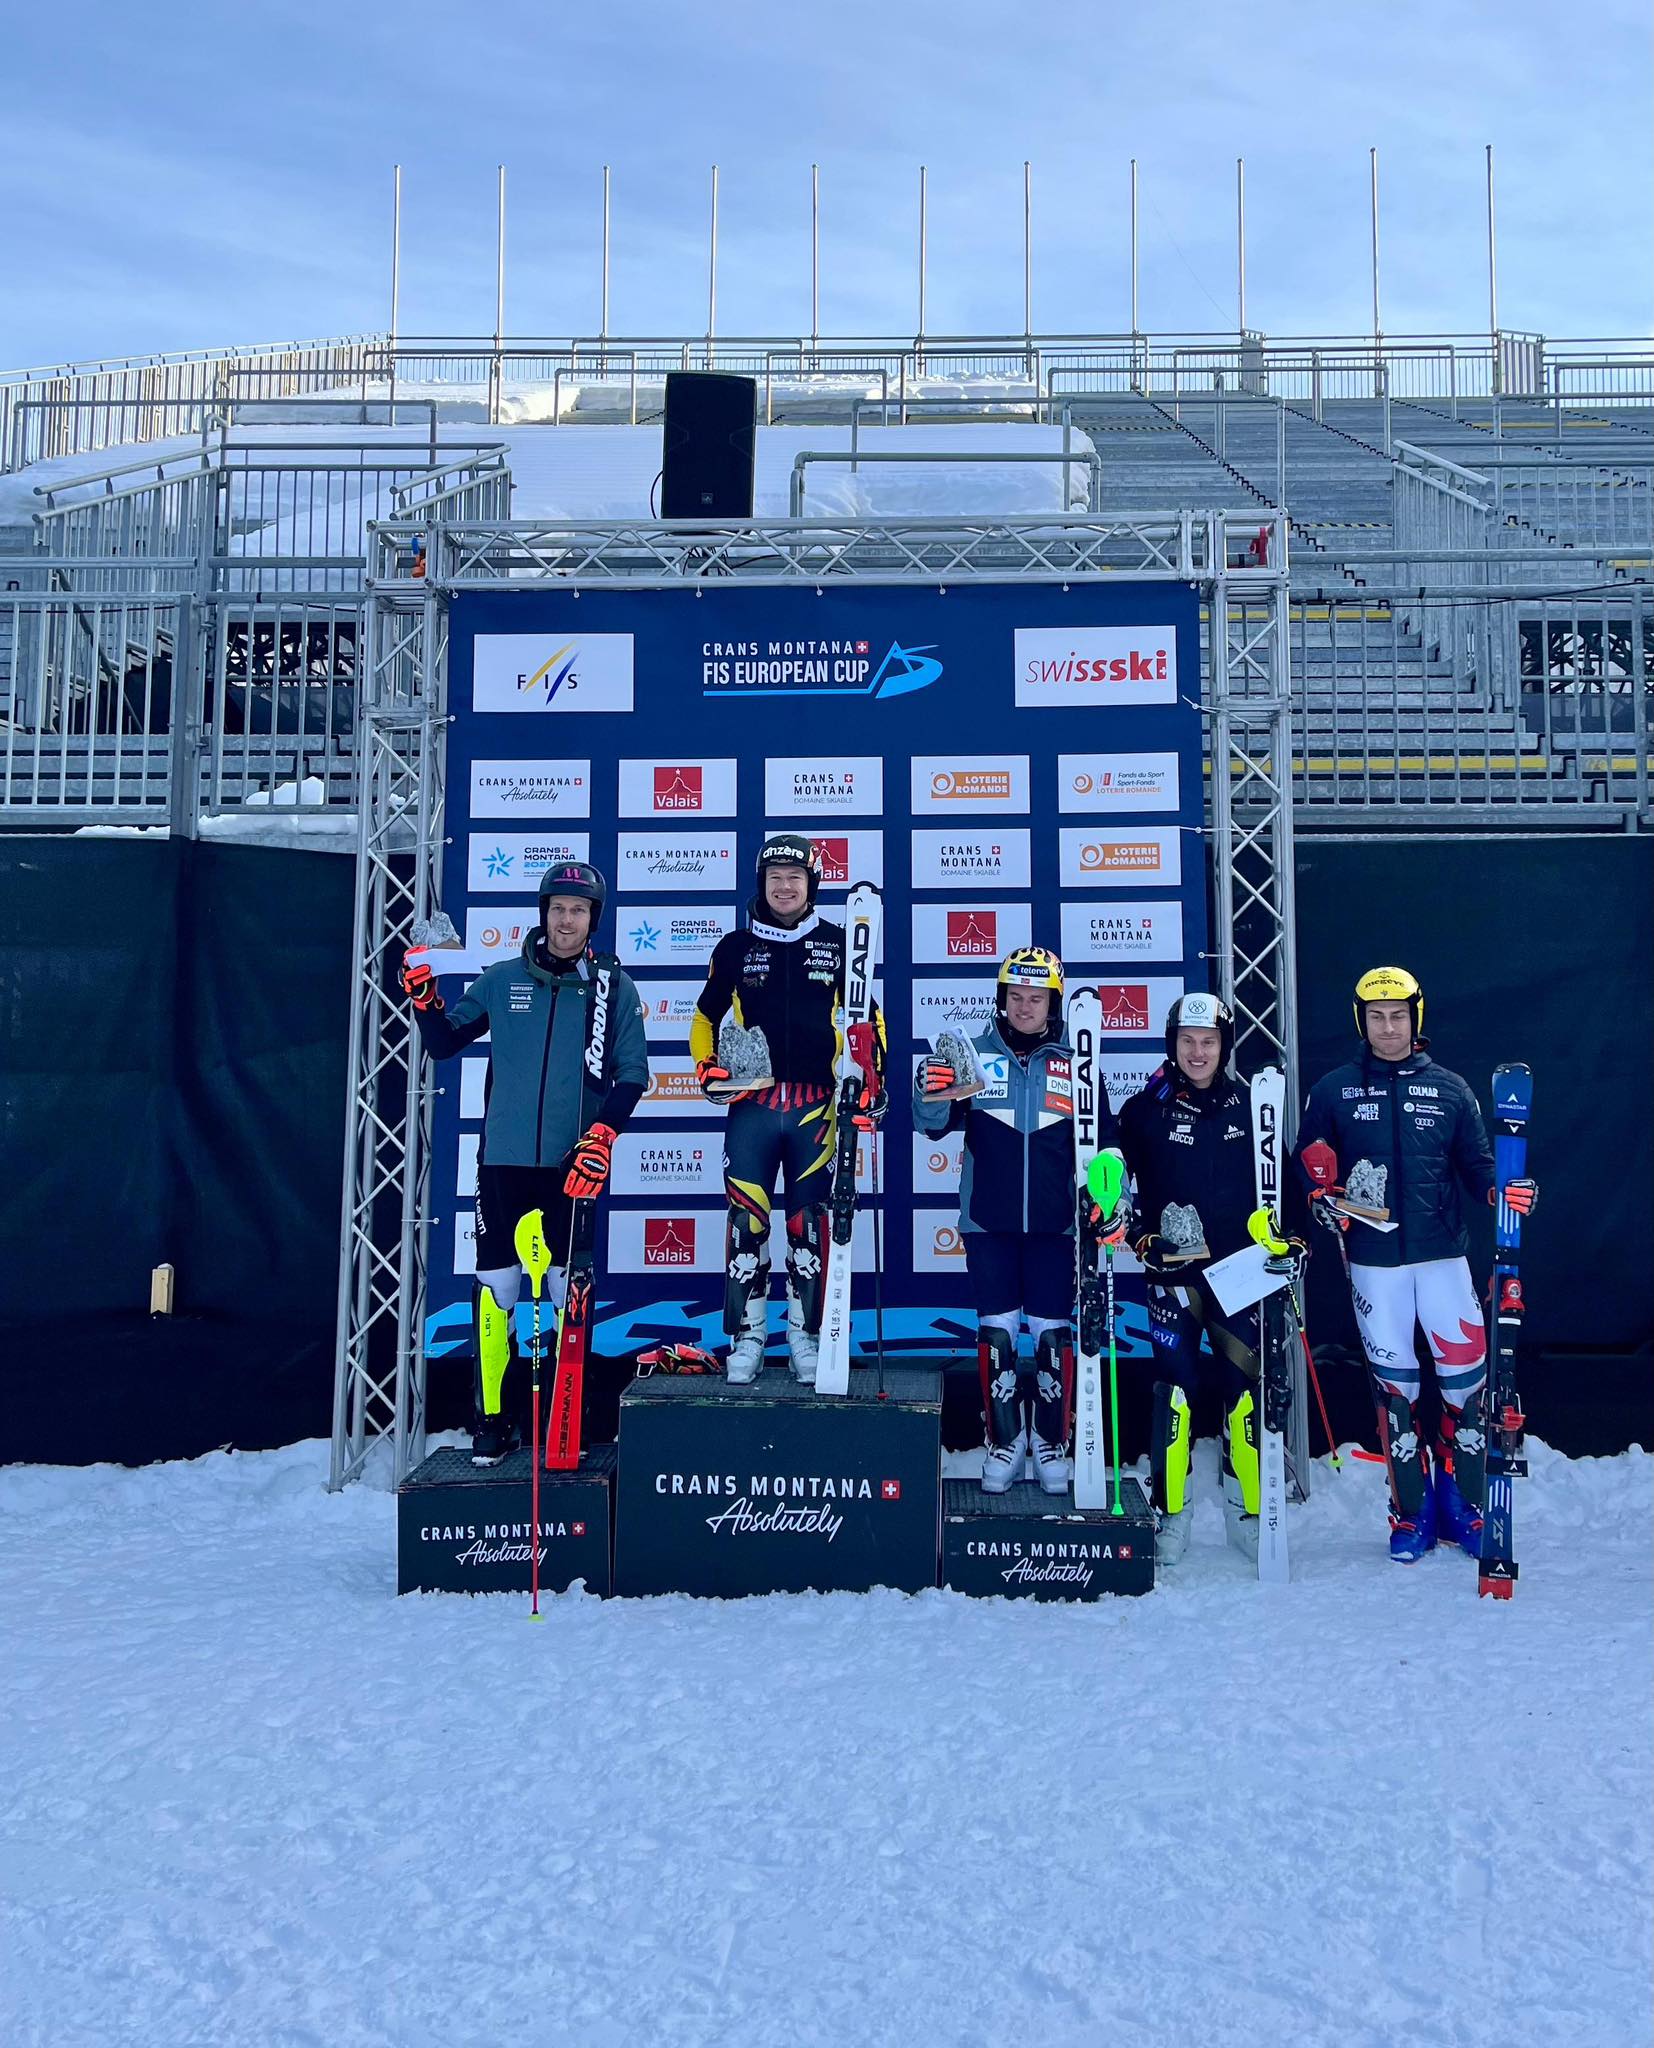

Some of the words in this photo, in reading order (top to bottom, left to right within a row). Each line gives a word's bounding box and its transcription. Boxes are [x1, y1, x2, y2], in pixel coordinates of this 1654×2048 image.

[703, 642, 758, 656] CRANS
[769, 640, 853, 656] MONTANA
[703, 661, 730, 684] FIS
[735, 660, 829, 684] EUROPEAN
[834, 659, 870, 683] CUP
[517, 674, 578, 690] FIS
[479, 777, 514, 786] CRANS
[520, 777, 571, 786] MONTANA
[794, 774, 834, 784] CRANS
[965, 775, 1008, 784] LOTERIE
[1146, 771, 1165, 779] Sport
[794, 784, 854, 795] MONTANA
[955, 784, 1008, 794] ROMANDE
[1117, 779, 1155, 787] Sport-Fonds
[501, 786, 559, 803] Absolutely
[656, 794, 699, 807] Valais
[626, 850, 660, 859] CRANS
[666, 849, 717, 858] MONTANA
[762, 845, 805, 860] anzère
[941, 846, 981, 855] CRANS
[1114, 847, 1158, 856] LOTERIE
[648, 859, 705, 875] Absolutely
[940, 857, 1001, 867] MONTANA
[1105, 856, 1158, 865] ROMANDE
[821, 865, 845, 879] lais
[1090, 918, 1132, 929] CRANS
[754, 925, 788, 939] OAKLEY
[1090, 931, 1152, 941] MONTANA
[950, 940, 993, 953] Valais
[803, 958, 835, 967] Adeps
[848, 922, 870, 1024] HEAD
[920, 997, 955, 1006] CRANS
[585, 969, 611, 1079] NORDICA
[1051, 1079, 1069, 1092] DNB
[1077, 1028, 1094, 1146] HEAD
[1408, 1085, 1439, 1098] COLMAR
[1357, 1103, 1379, 1113] GREEN
[1361, 1111, 1380, 1120] WEEZ
[1168, 1131, 1195, 1146] NOCCO
[641, 1150, 682, 1160] CRANS
[1259, 1103, 1277, 1206] HEAD
[640, 1162, 702, 1172] MONTANA
[646, 1248, 691, 1262] Valais
[1171, 1415, 1179, 1440] LEKI
[1244, 1417, 1252, 1442] LEKI
[654, 1474, 737, 1495] CRANS
[751, 1476, 872, 1499] MONTANA
[705, 1497, 844, 1543] Absolutely
[420, 1525, 476, 1541] CRANS
[967, 1542, 1022, 1556] CRANS
[1031, 1543, 1113, 1559] MONTANA
[1001, 1557, 1094, 1588] Absolutely
